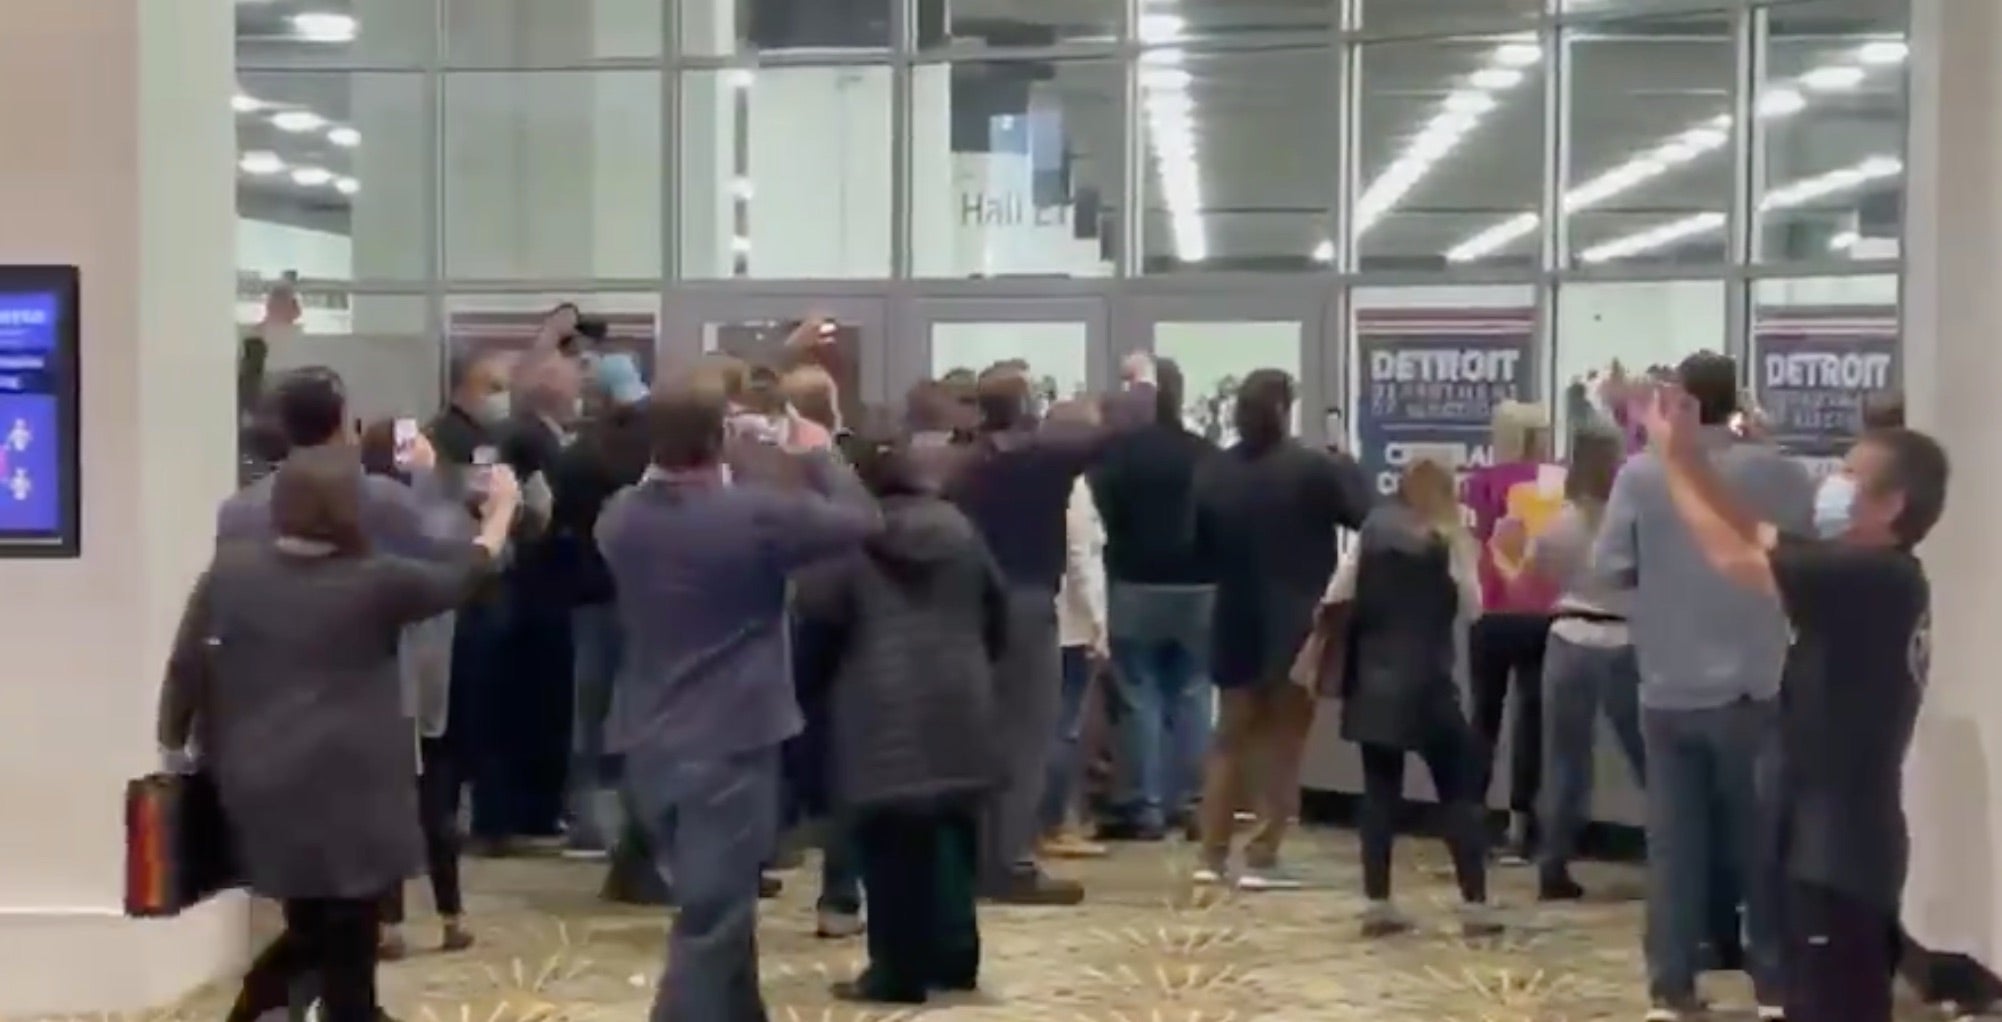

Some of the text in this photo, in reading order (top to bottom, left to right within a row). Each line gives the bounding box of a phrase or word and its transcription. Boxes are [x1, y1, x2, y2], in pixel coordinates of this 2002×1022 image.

[961, 190, 1022, 226] Hall
[1371, 349, 1519, 382] DETROIT
[1766, 353, 1890, 388] DETROIT
